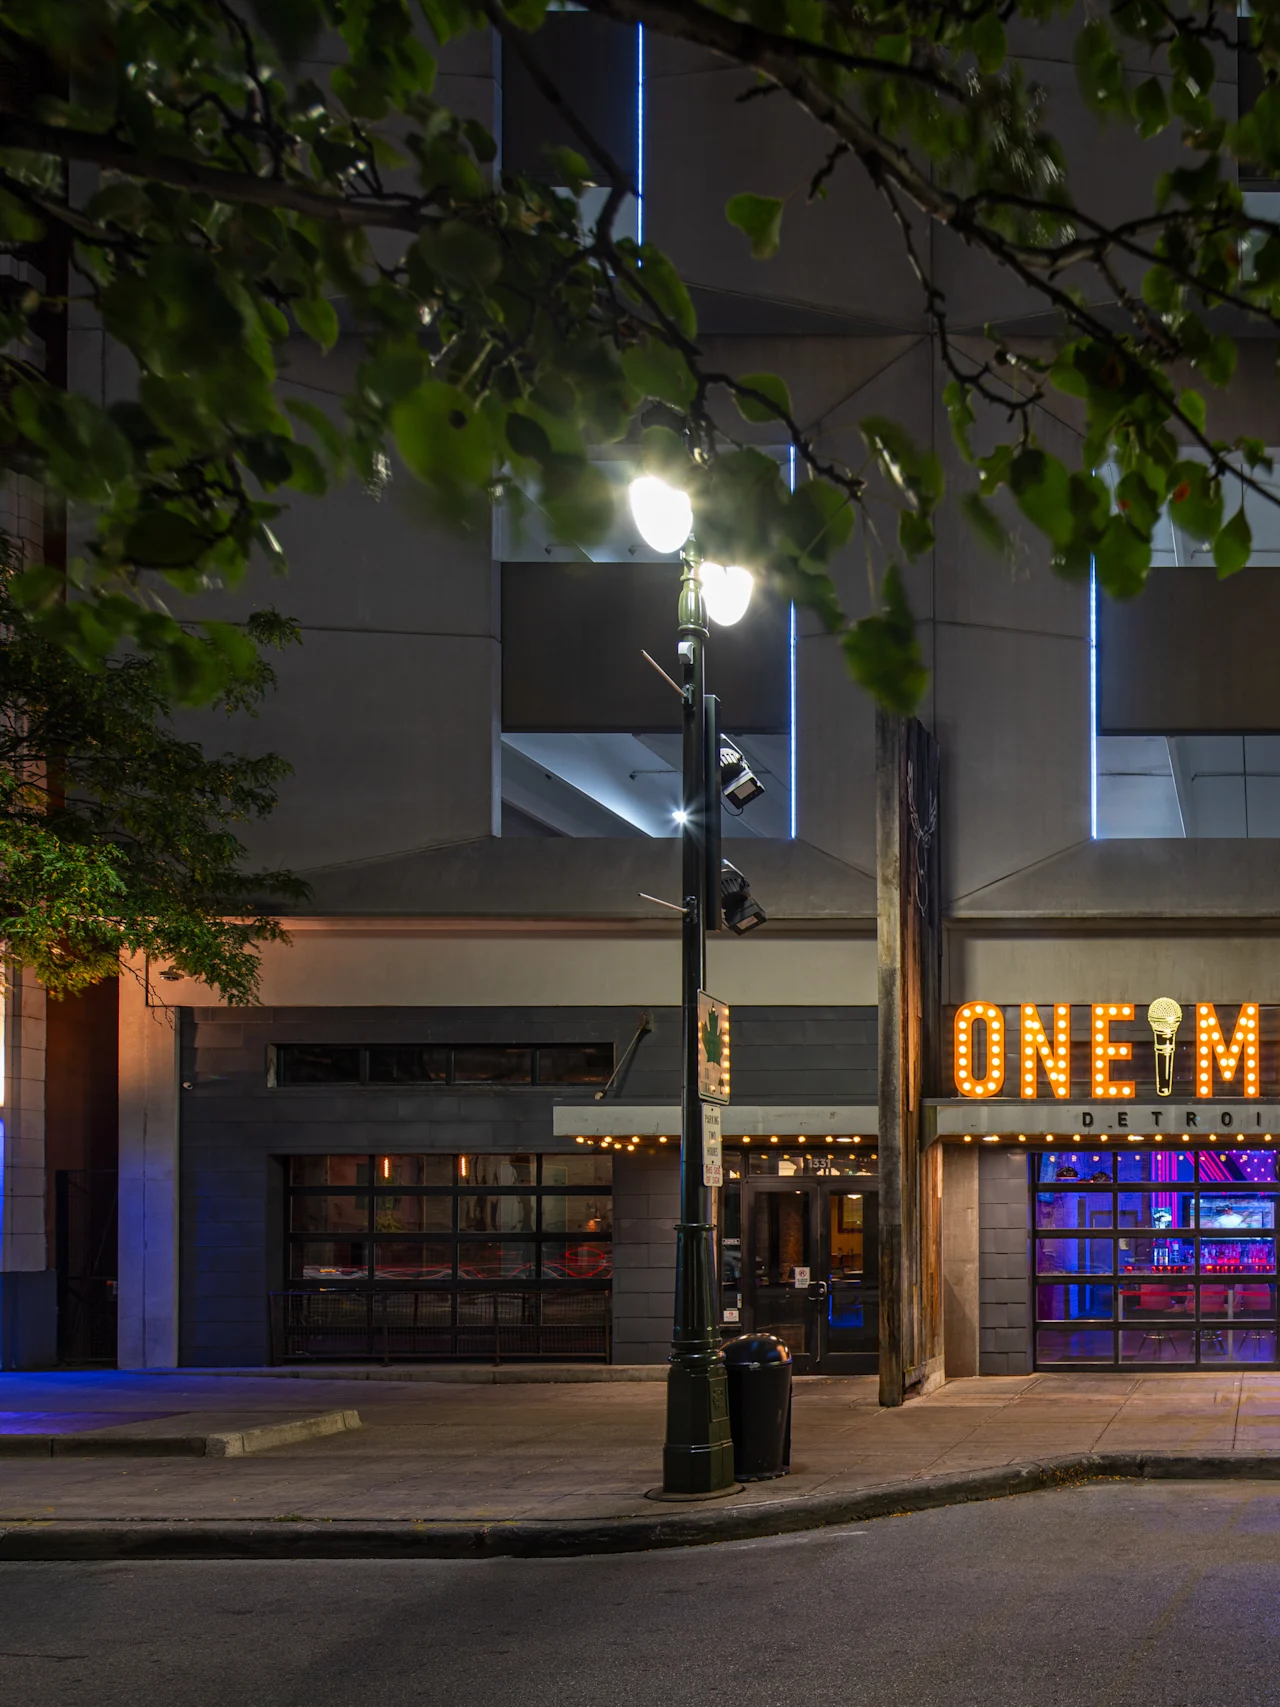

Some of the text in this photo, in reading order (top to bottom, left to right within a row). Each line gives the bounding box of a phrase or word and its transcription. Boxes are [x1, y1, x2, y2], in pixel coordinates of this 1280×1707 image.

[954, 1001, 1136, 1098] ONE
[704, 1114, 719, 1125] PARKING
[708, 1131, 716, 1141] TWO
[706, 1146, 718, 1156] HOURS
[808, 1158, 831, 1168] 1331
[705, 1166, 721, 1175] THIS SIDE
[705, 1176, 720, 1185] OF SIGN
